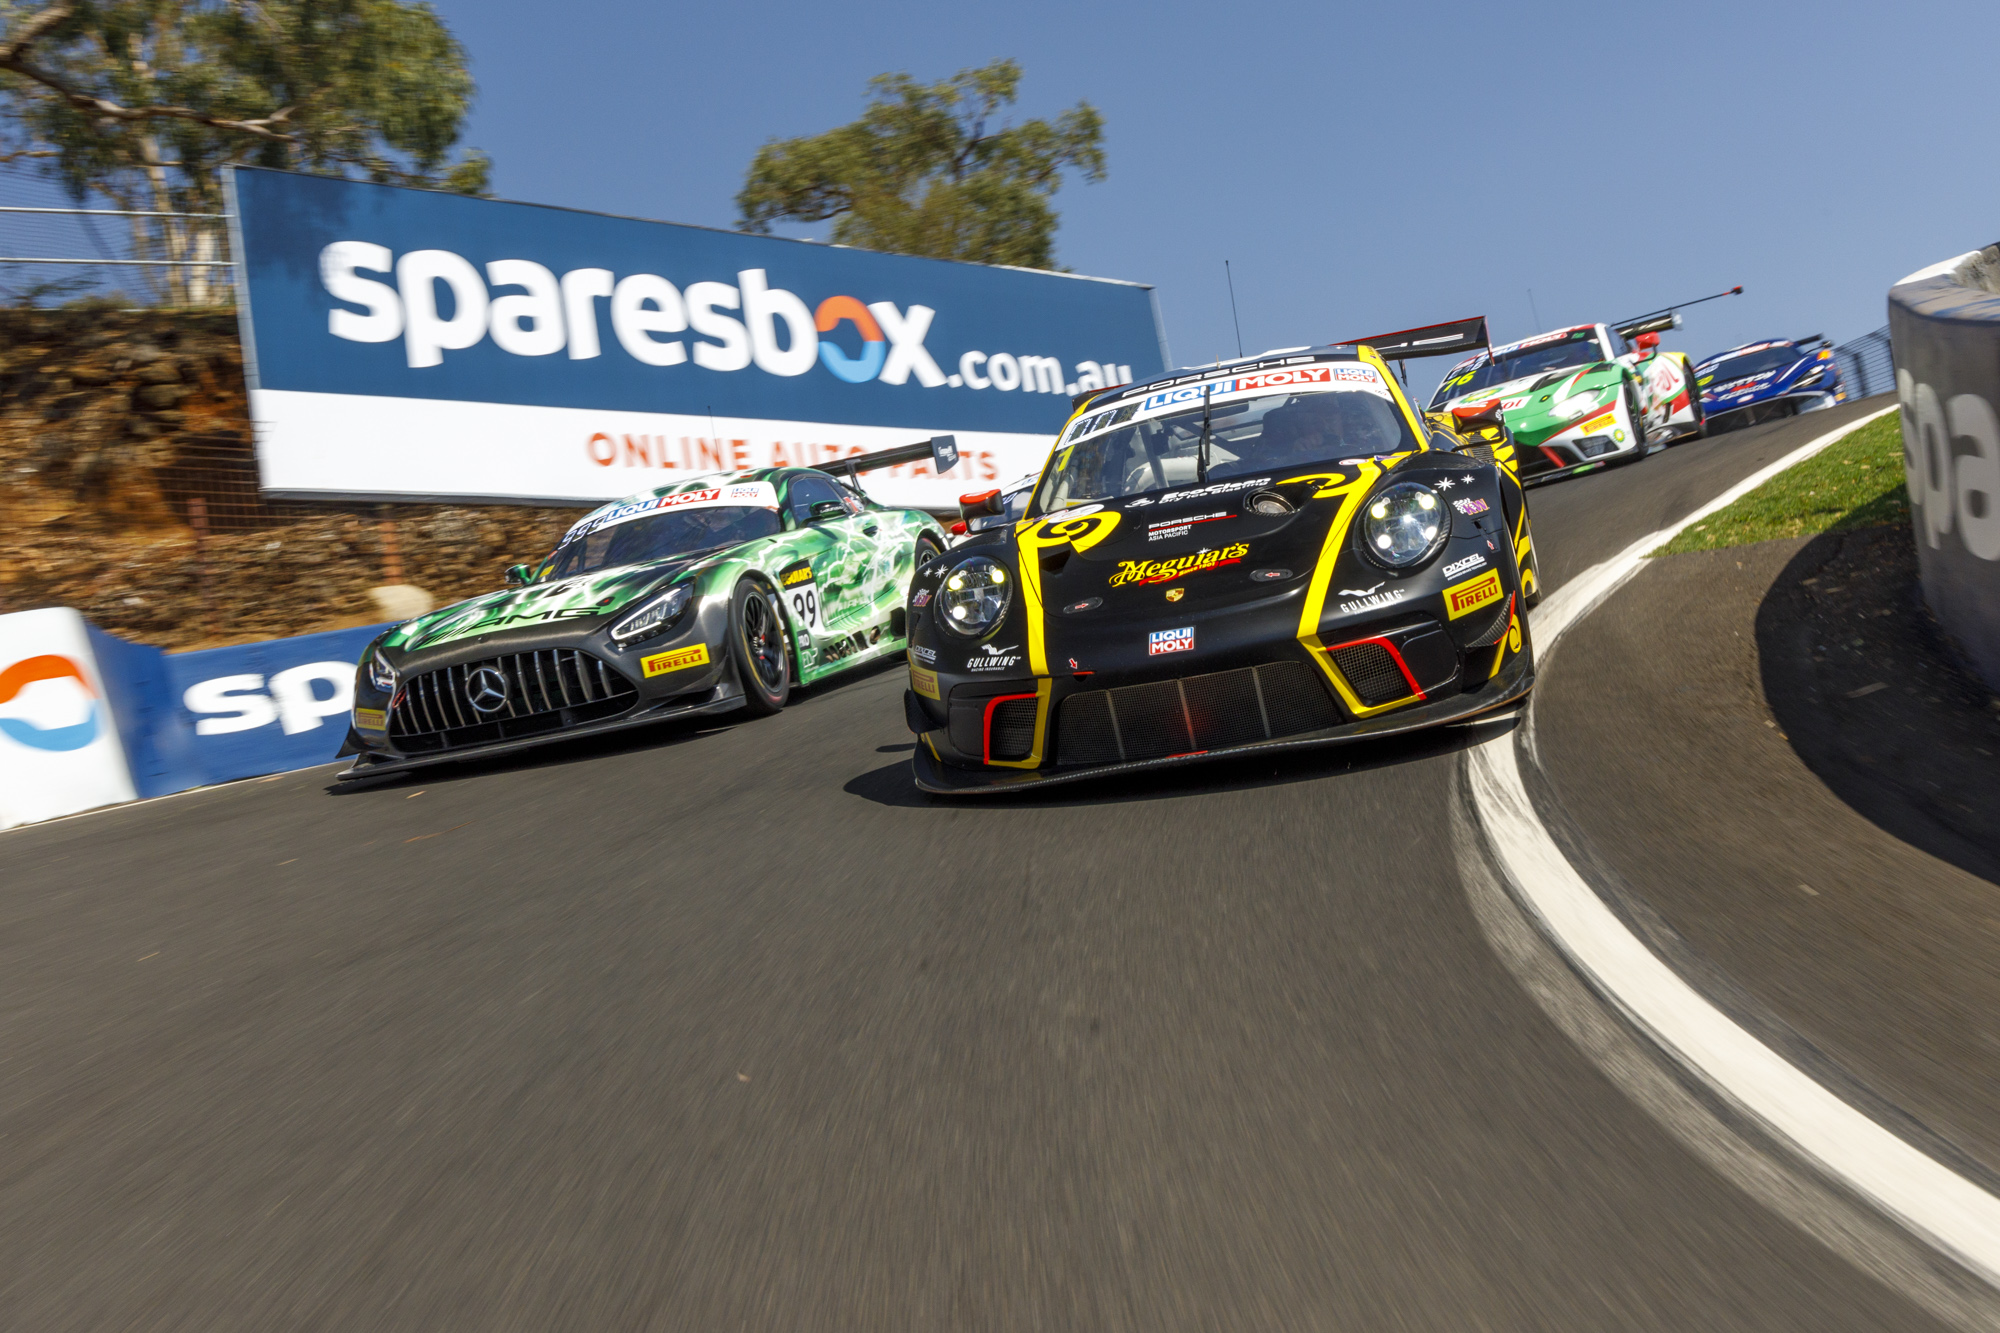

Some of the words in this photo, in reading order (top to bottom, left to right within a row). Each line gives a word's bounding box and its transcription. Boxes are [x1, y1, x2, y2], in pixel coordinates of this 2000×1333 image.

[1121, 355, 1315, 398] PORSCHE
[1336, 367, 1376, 377] LIQUI
[1336, 374, 1376, 384] MOLY
[1442, 370, 1477, 393] 76
[1148, 382, 1234, 410] LIQUI
[1237, 368, 1330, 391] MOLY
[585, 431, 752, 472] ONLINE
[1160, 478, 1271, 500] EcoClean
[606, 498, 660, 523] LIQUI
[661, 488, 720, 508] MOLY
[1148, 511, 1227, 530] PORSCHE
[1148, 524, 1192, 537] MOTORSPORT
[1148, 534, 1163, 542] ASIA
[1164, 530, 1189, 540] PACIFIC
[1109, 543, 1250, 588] Meguiar's
[1442, 553, 1486, 575] DIXCEL
[1340, 588, 1403, 614] GULLWING
[1451, 576, 1498, 612] PIRELLI
[1151, 628, 1192, 643] LIQUI
[1151, 638, 1192, 654] MOLY
[648, 648, 703, 673] PIRELLI
[966, 656, 1016, 669] GULLWING
